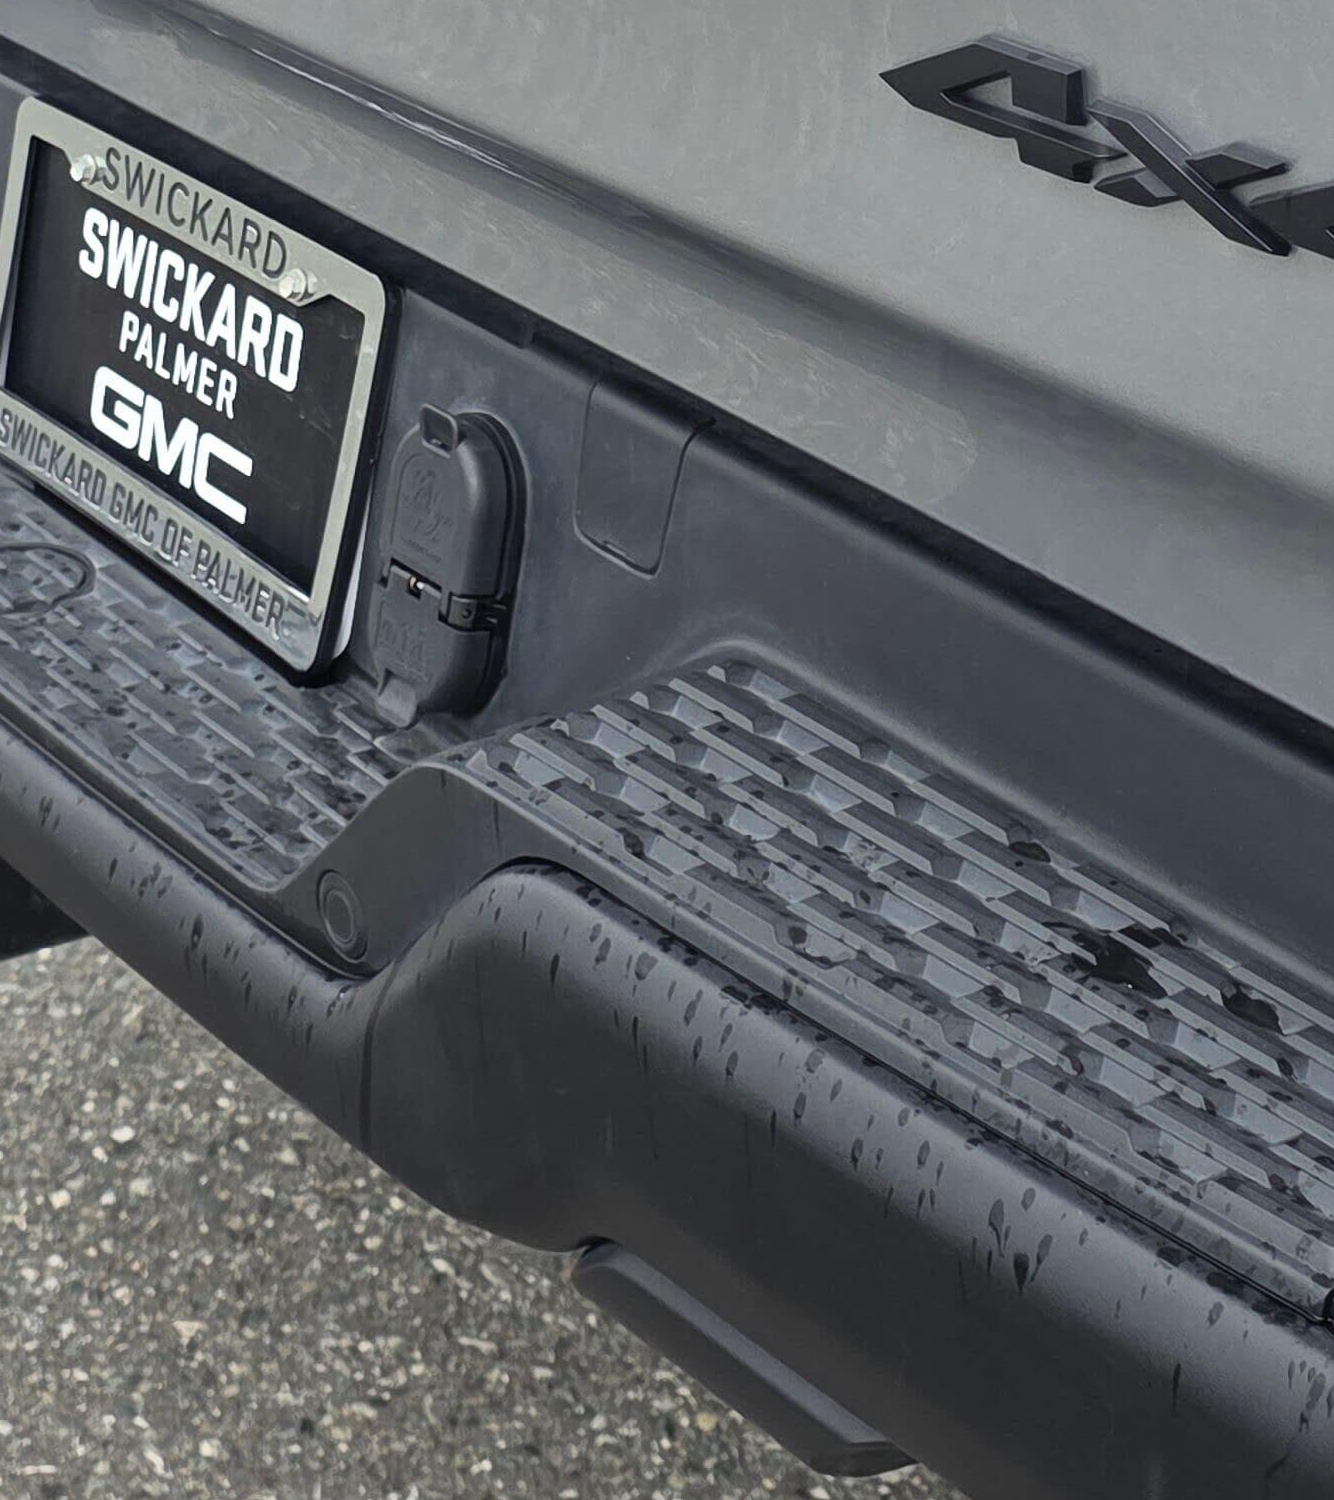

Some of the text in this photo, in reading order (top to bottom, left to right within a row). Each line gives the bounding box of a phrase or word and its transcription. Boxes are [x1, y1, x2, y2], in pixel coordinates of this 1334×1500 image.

[103, 147, 288, 280] SWICKARD
[78, 207, 304, 392] SWICKARD
[119, 310, 238, 419] PALMER
[90, 366, 253, 525] GMC
[110, 482, 159, 547] GMC
[161, 517, 193, 566] OF
[192, 540, 285, 640] PALMER
